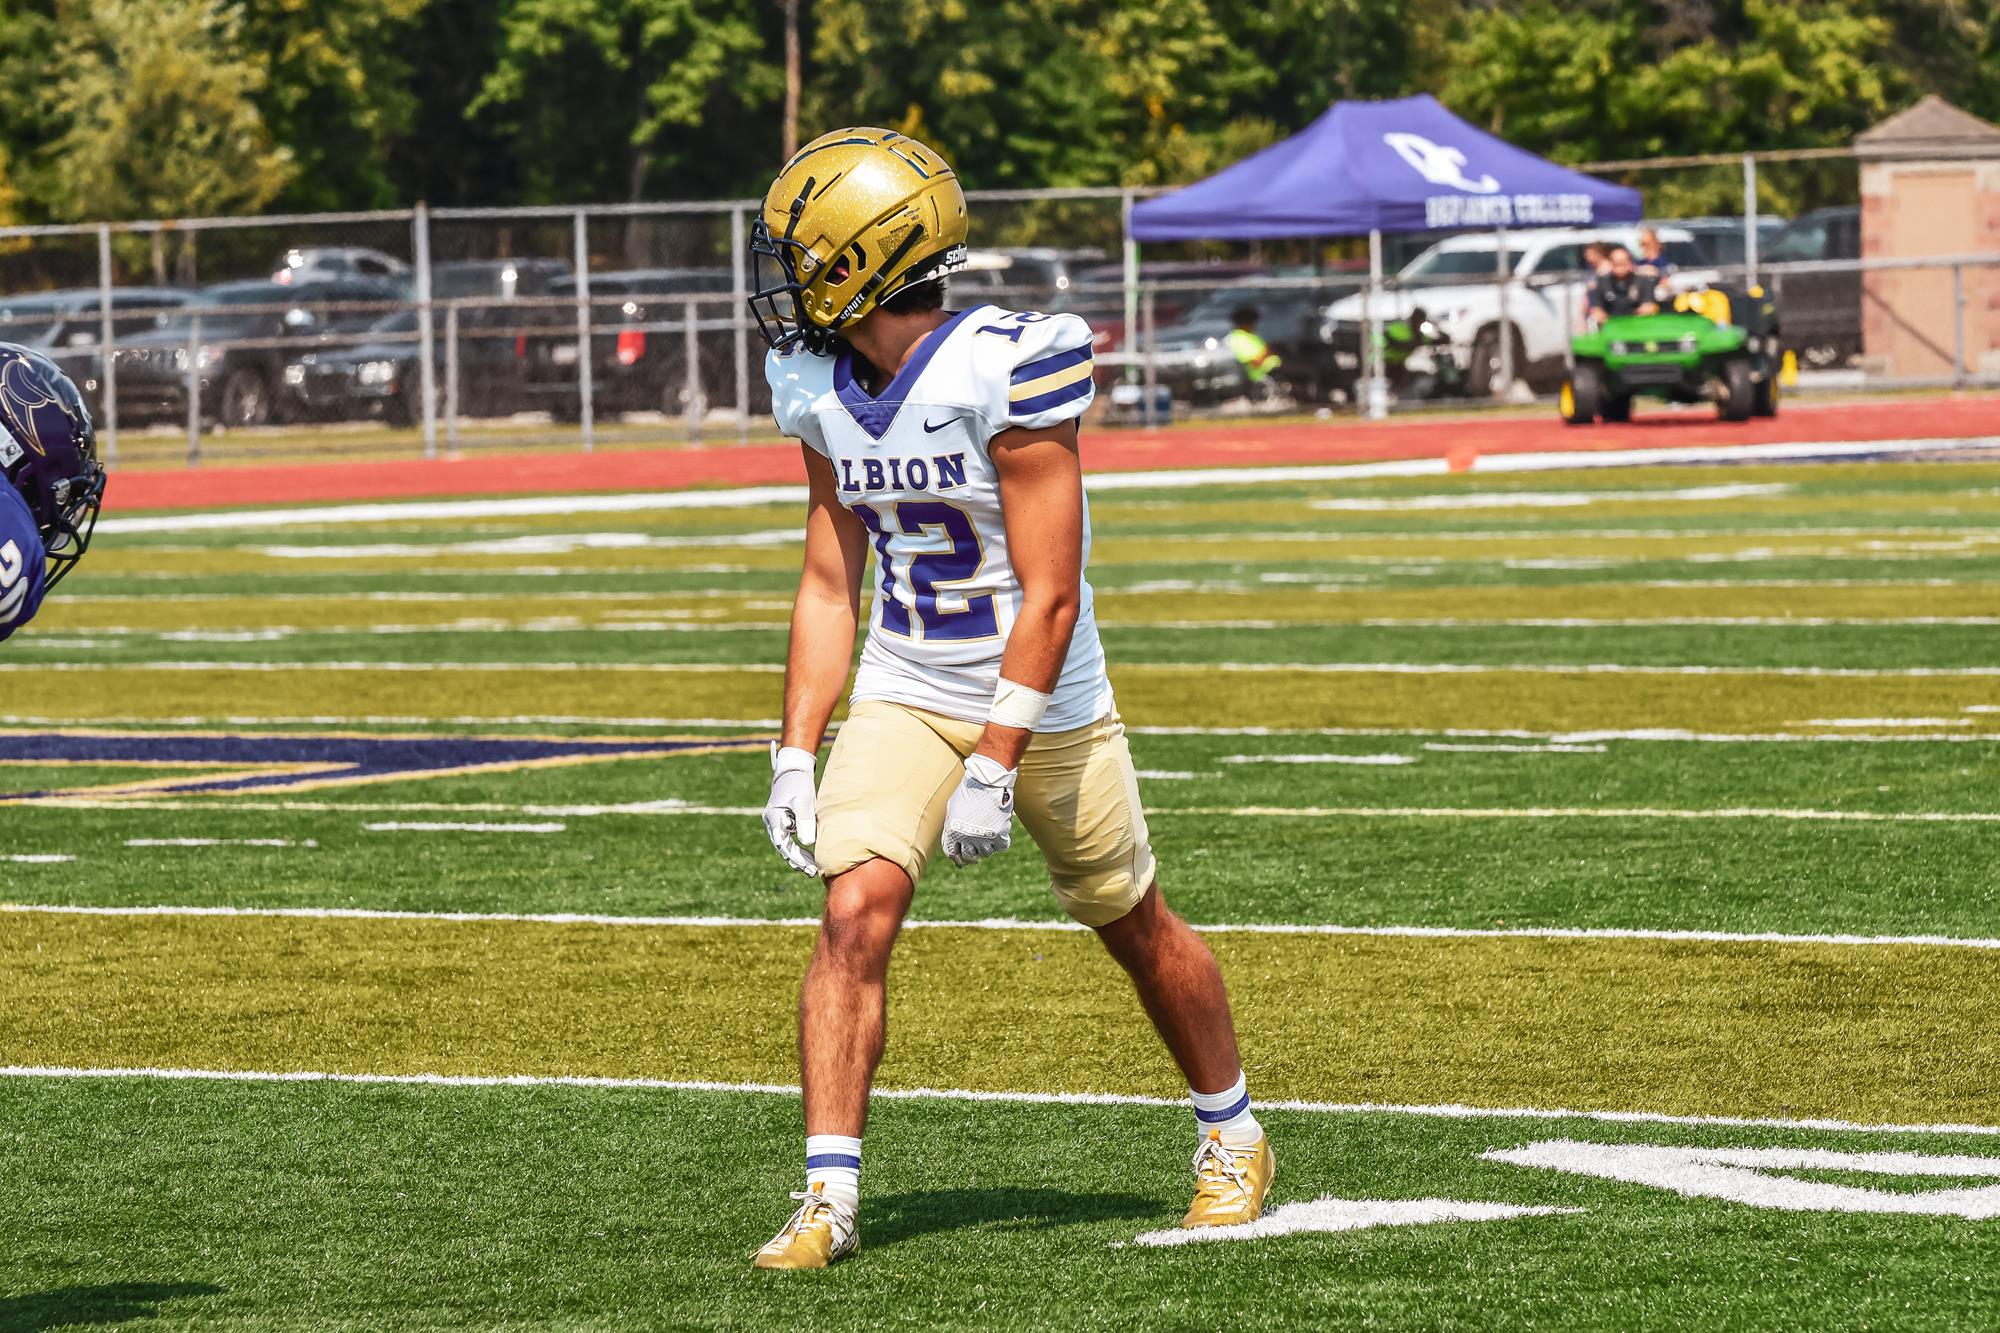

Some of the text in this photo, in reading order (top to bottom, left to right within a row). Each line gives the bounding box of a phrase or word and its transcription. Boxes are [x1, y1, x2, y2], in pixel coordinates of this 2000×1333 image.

[840, 292, 866, 320] schutt
[829, 450, 969, 494] LBION
[848, 500, 1003, 644] 12
